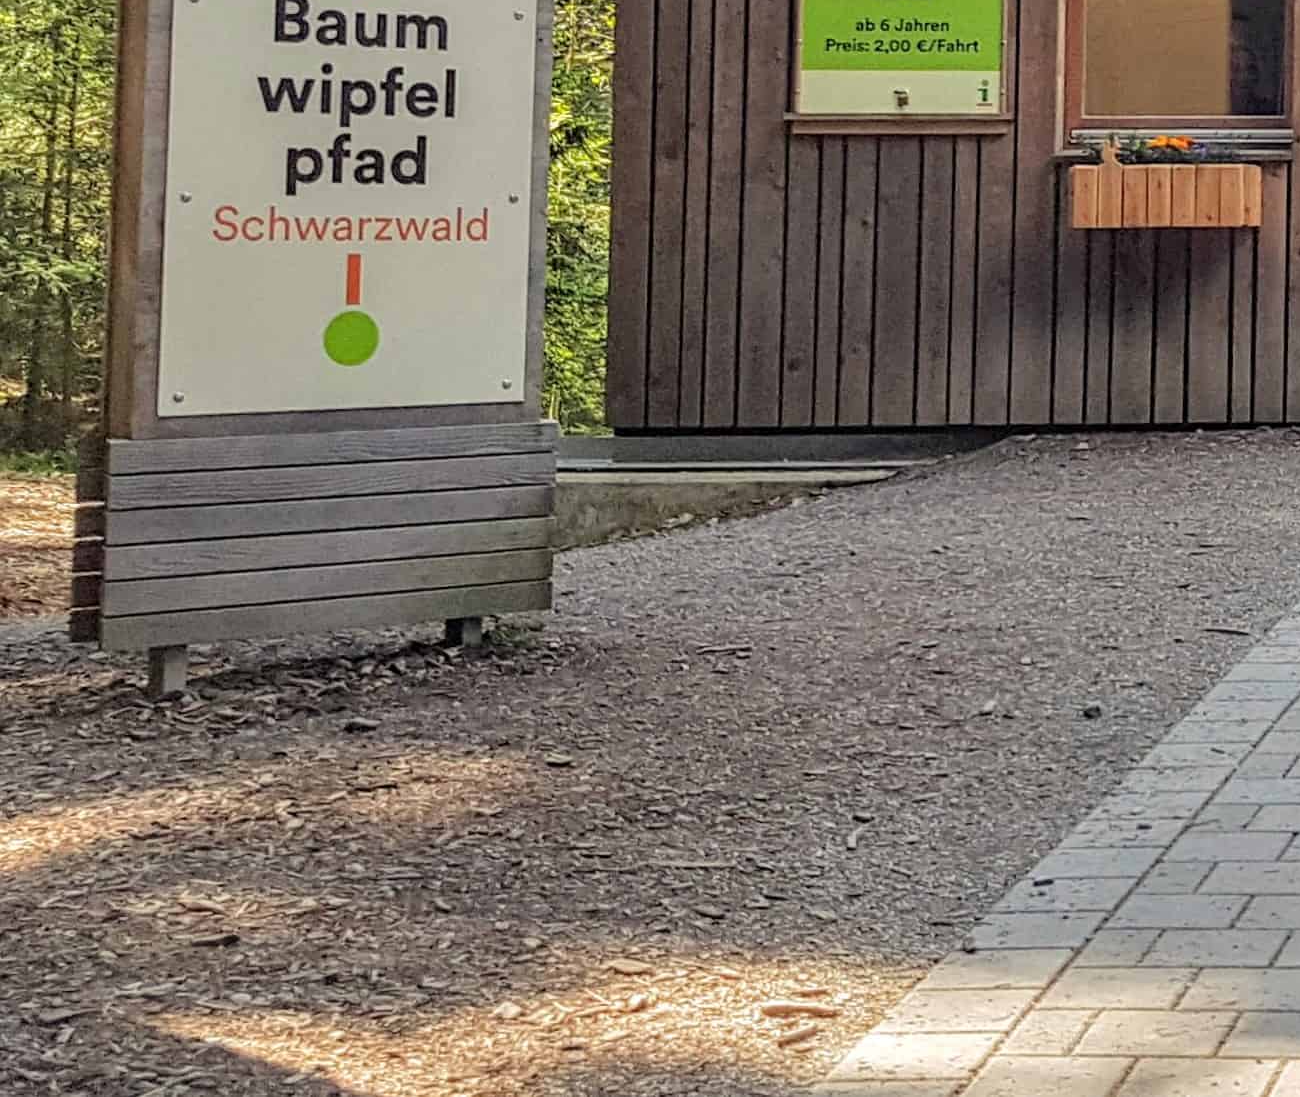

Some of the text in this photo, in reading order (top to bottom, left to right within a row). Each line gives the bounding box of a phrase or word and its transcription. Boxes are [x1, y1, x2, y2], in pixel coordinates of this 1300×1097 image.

[856, 19, 950, 32] ab 6 Jahren
[825, 39, 979, 54] Preis: 2,00 €/Fahrt
[257, 63, 456, 127] wipfel
[285, 133, 427, 196] pfad
[212, 206, 489, 242] Schwarzwald
